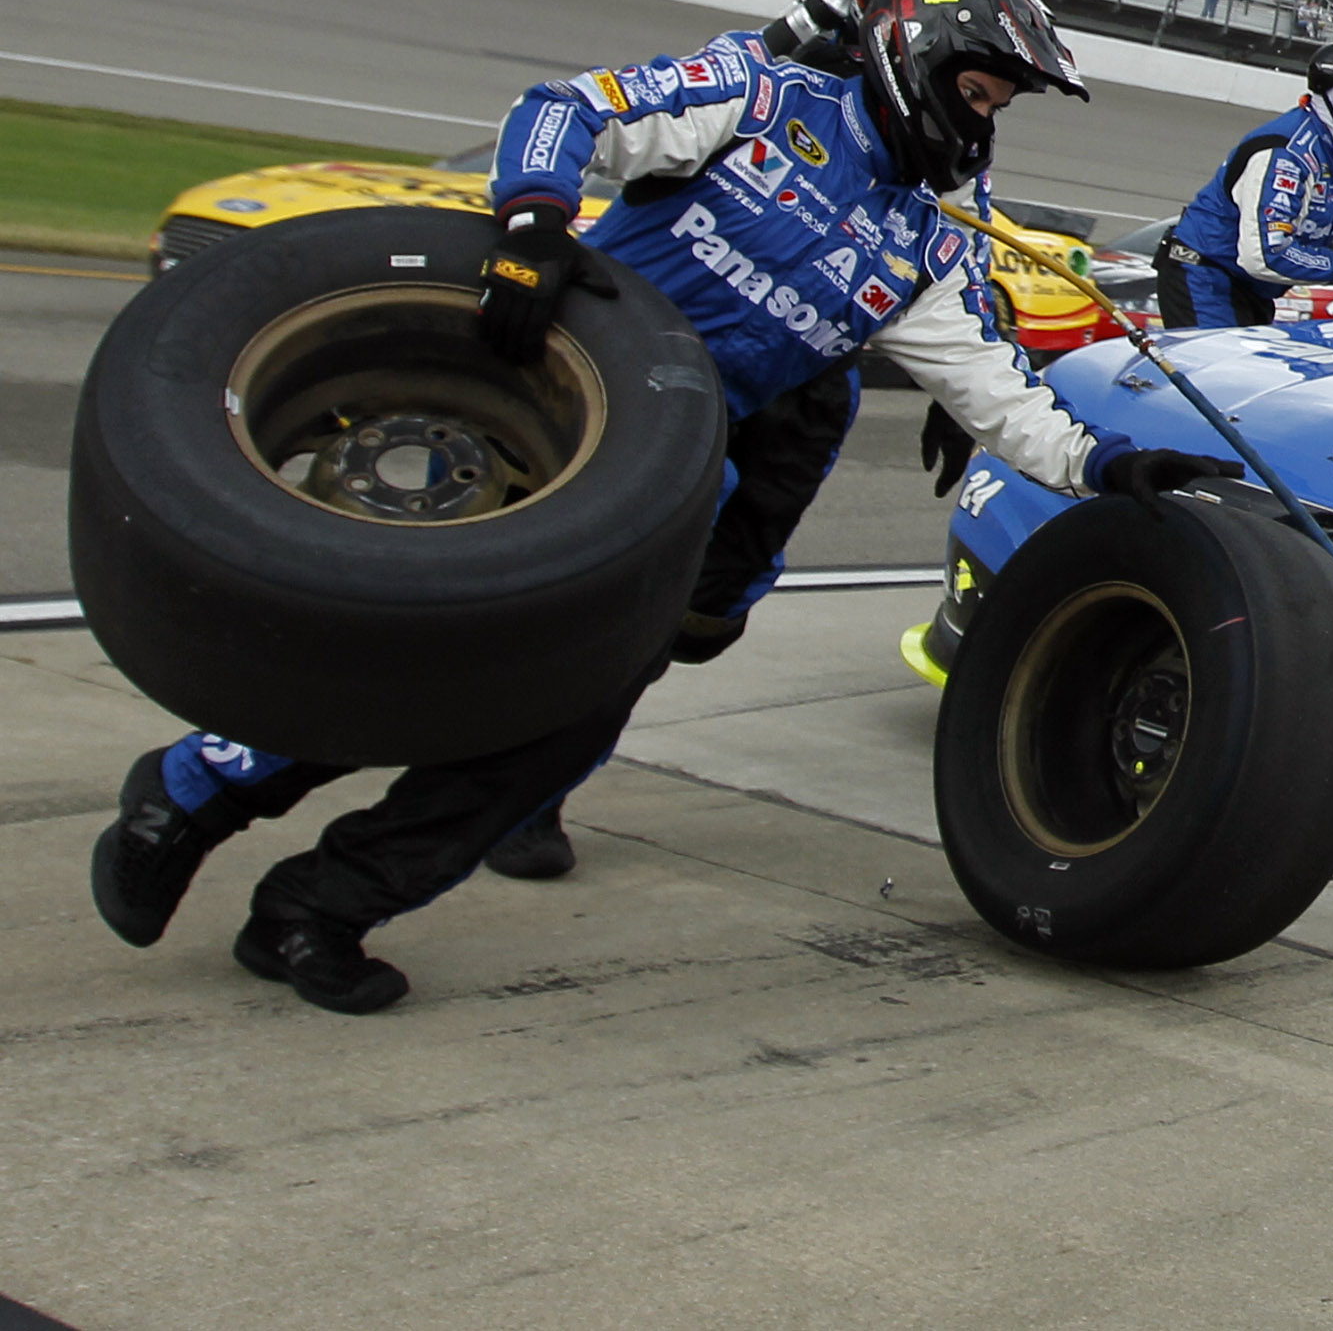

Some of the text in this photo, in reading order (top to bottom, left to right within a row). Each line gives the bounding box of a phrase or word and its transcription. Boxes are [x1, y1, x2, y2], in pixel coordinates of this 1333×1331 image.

[600, 76, 624, 111] BOSCH
[1276, 177, 1297, 191] 3M
[795, 205, 832, 237] pepsi
[670, 202, 859, 359] Panasonic
[812, 257, 850, 295] AXALTA
[861, 283, 897, 315] 3M
[959, 469, 1006, 518] 24
